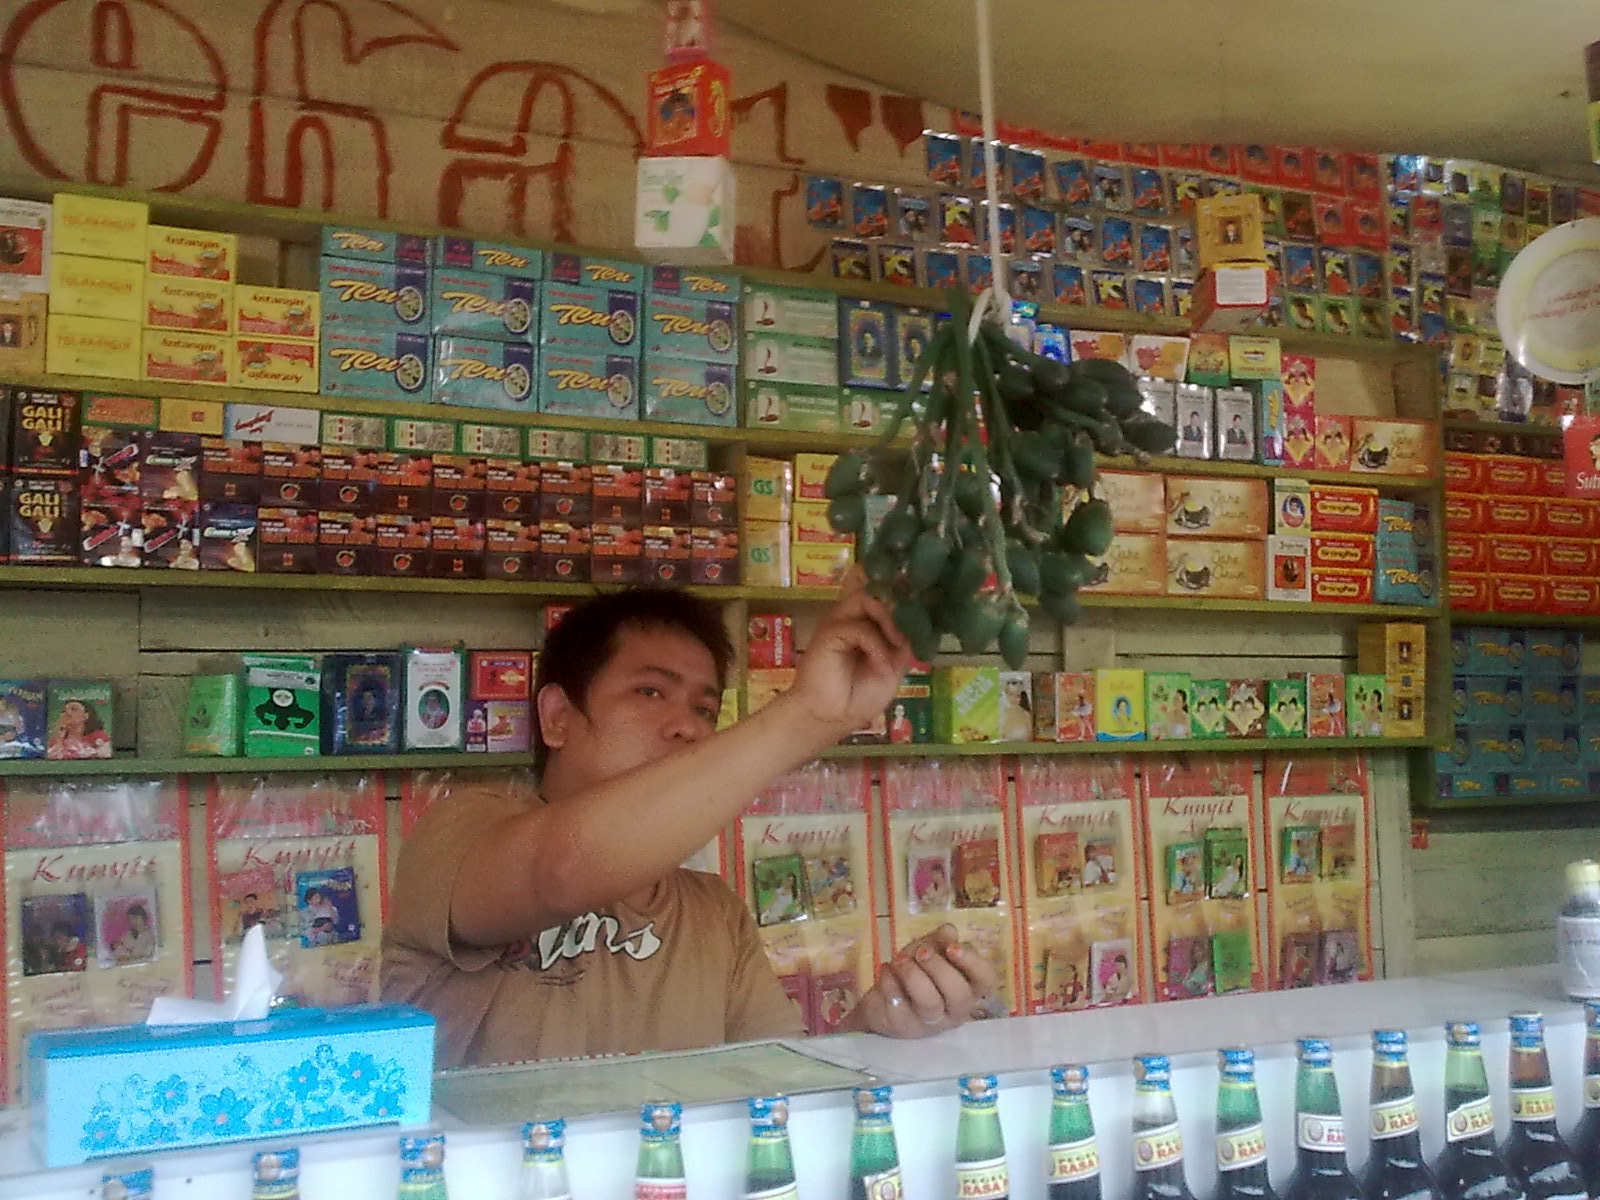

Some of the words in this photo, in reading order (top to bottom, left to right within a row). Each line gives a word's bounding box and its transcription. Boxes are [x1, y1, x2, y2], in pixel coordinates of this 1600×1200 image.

[21, 404, 63, 419] GALI
[21, 417, 63, 432] GALI
[18, 492, 61, 506] GALI
[18, 504, 61, 519] GALI
